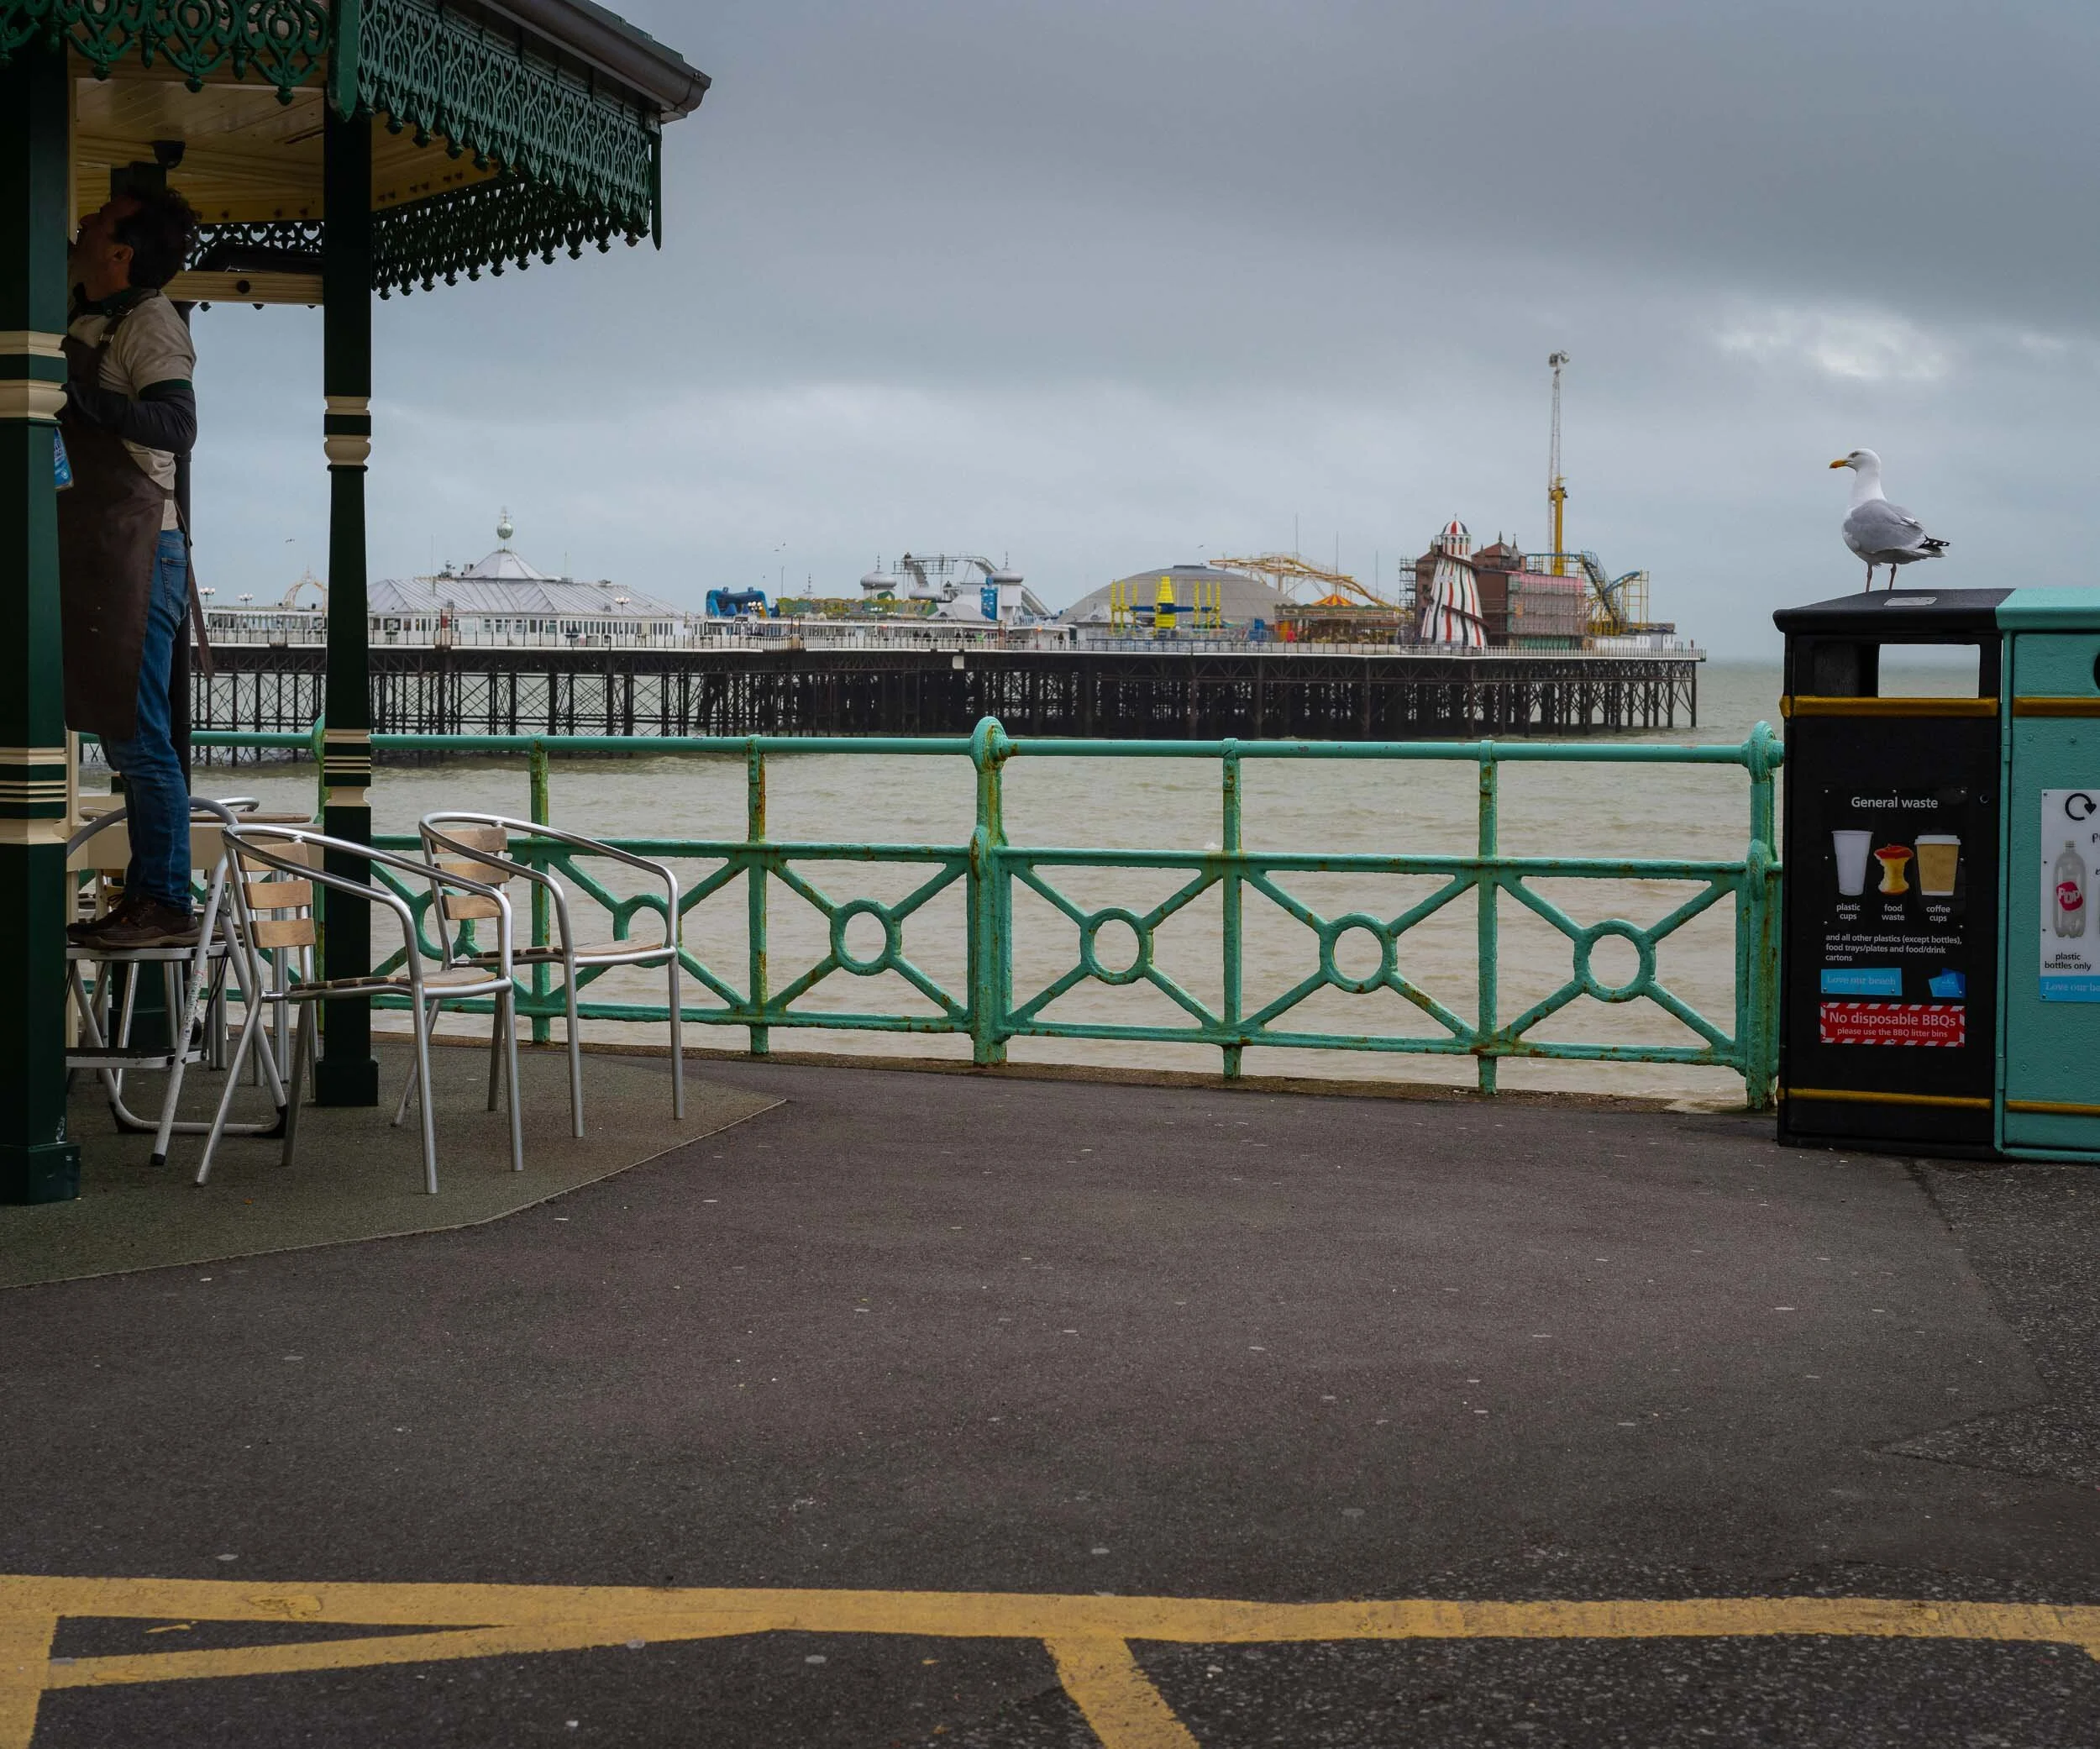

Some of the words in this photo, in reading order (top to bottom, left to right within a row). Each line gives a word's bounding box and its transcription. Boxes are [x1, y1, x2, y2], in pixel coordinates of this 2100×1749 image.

[1851, 796, 1898, 808] General
[1901, 798, 1939, 808] waste
[1836, 903, 1861, 912] plastic
[1883, 904, 1903, 912] food
[1926, 905, 1950, 913] coffee
[1929, 915, 1947, 923] cups
[1873, 935, 1901, 943] plastics
[1902, 935, 1929, 944] (except
[1931, 936, 1962, 945] bottles),
[1845, 943, 1888, 953] trays/plates
[1906, 945, 1946, 953] food/drink
[2055, 952, 2081, 961] plastic
[2045, 961, 2072, 969] bottles
[2074, 962, 2092, 971] only
[1830, 1012, 1848, 1023] No
[1851, 1012, 1919, 1027] disposable
[1922, 1014, 1956, 1027] BBQs
[1893, 1029, 1909, 1037] BBQ
[1911, 1029, 1930, 1037] litter
[1931, 1029, 1948, 1037] bins
